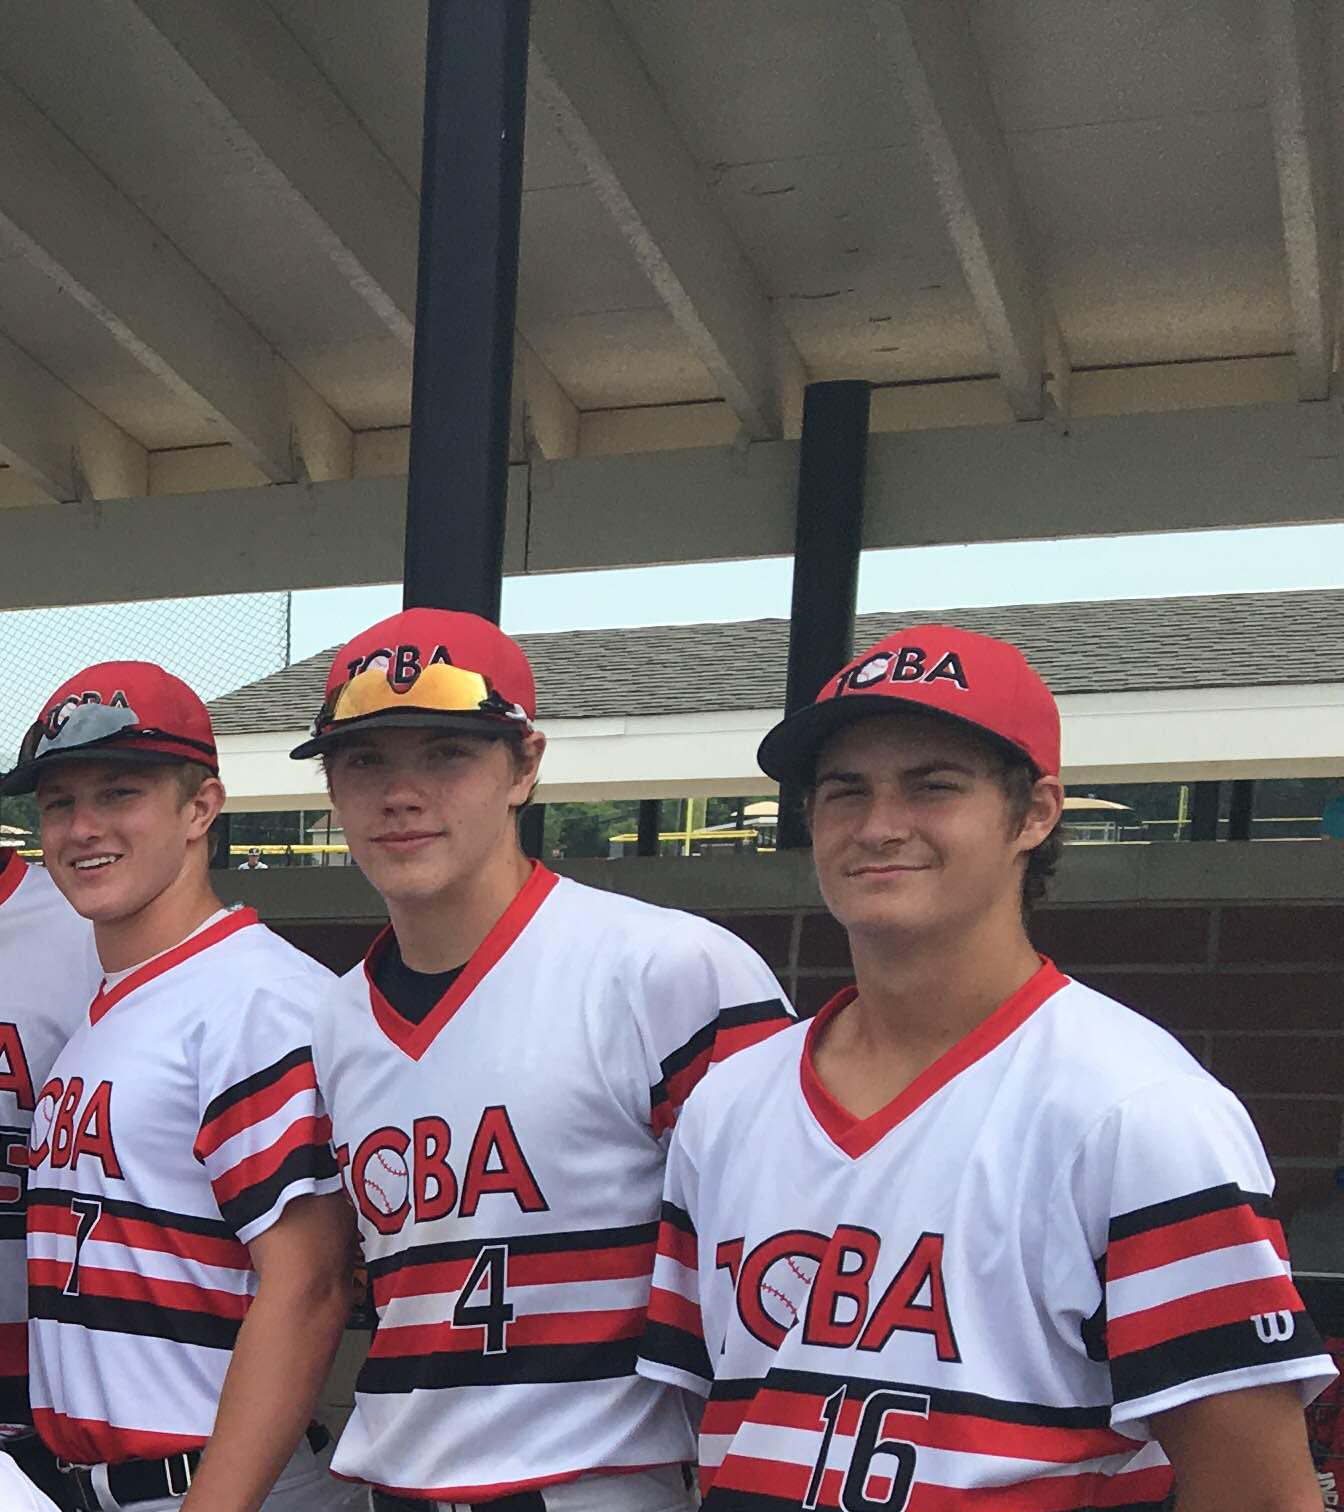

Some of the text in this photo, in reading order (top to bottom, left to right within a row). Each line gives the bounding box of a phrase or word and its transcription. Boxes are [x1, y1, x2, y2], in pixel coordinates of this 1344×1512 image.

[29, 1076, 126, 1181] CBA
[336, 1104, 551, 1236] CBA
[63, 1197, 103, 1297] 7
[449, 1243, 518, 1357] 4
